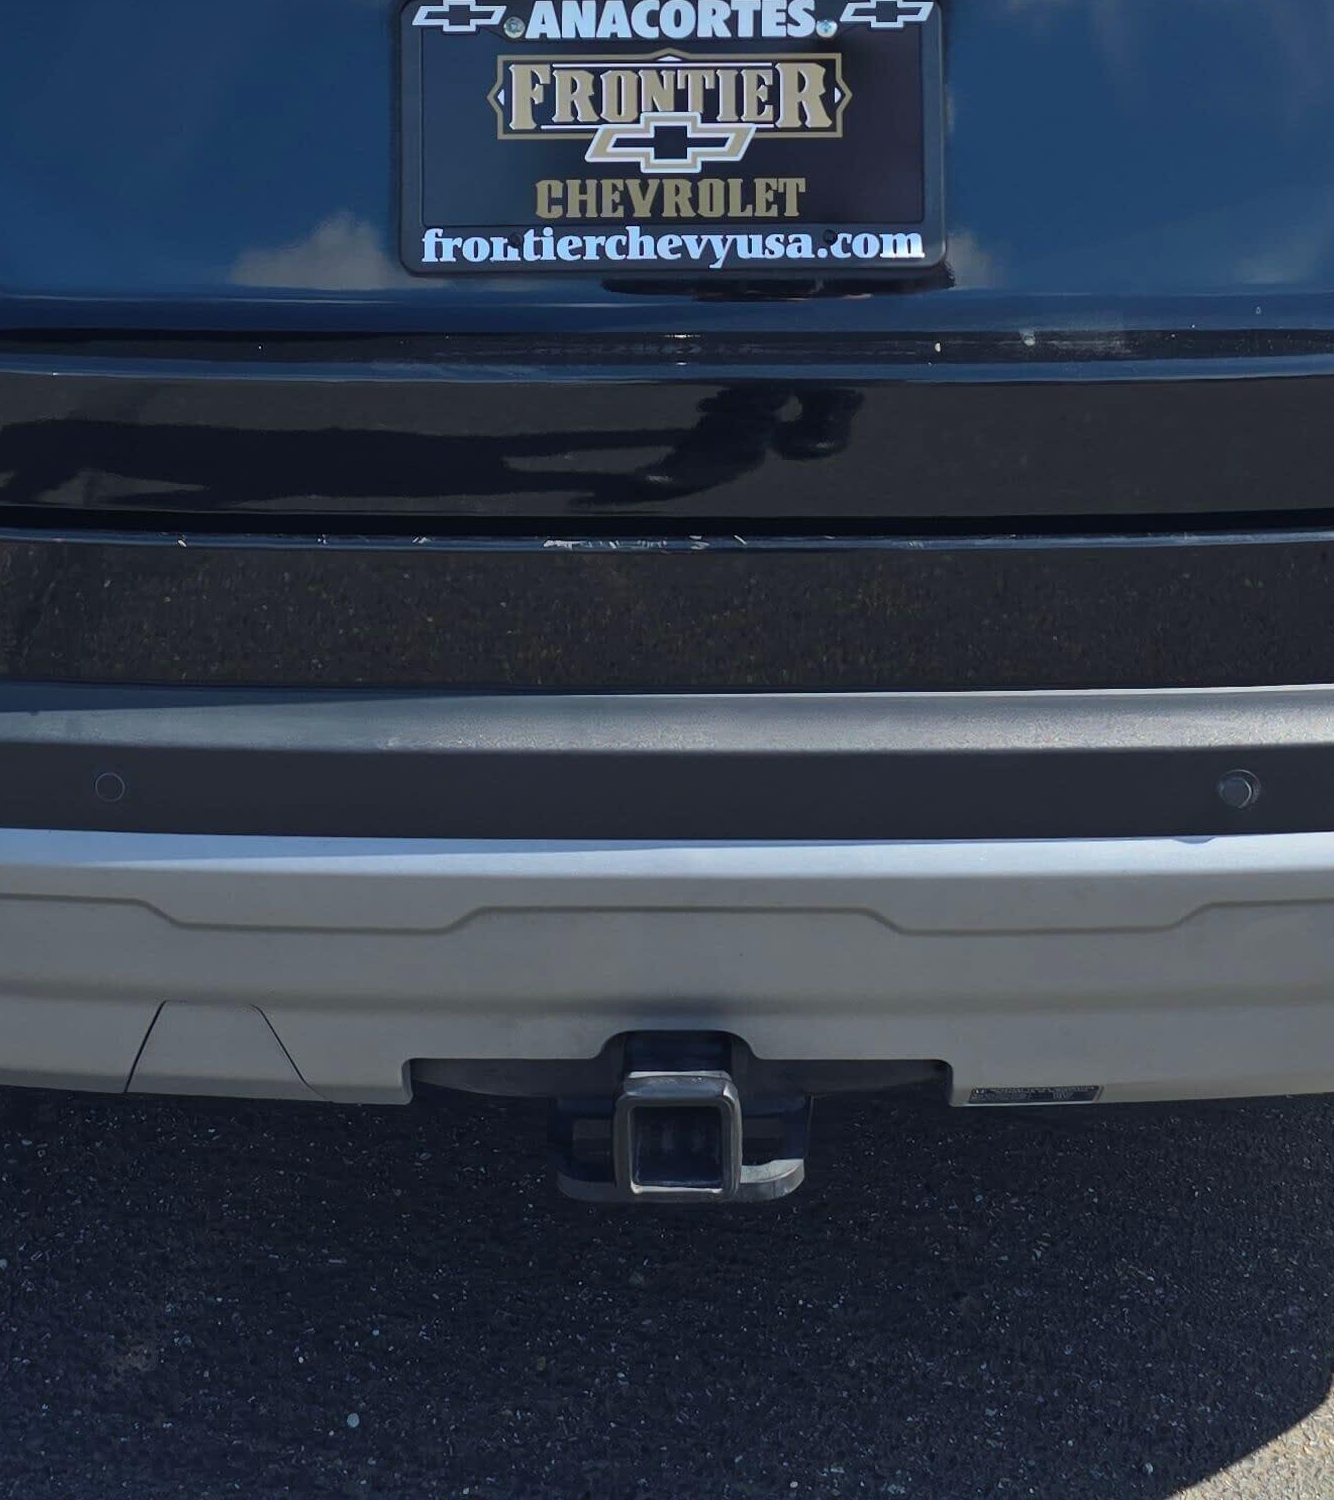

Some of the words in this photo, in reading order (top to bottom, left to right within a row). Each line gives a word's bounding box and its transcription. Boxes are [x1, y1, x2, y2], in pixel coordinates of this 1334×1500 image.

[507, 61, 834, 131] FRONTIER
[534, 177, 807, 219] CHEVROLET
[421, 225, 926, 269] frontierchevyusa.com
